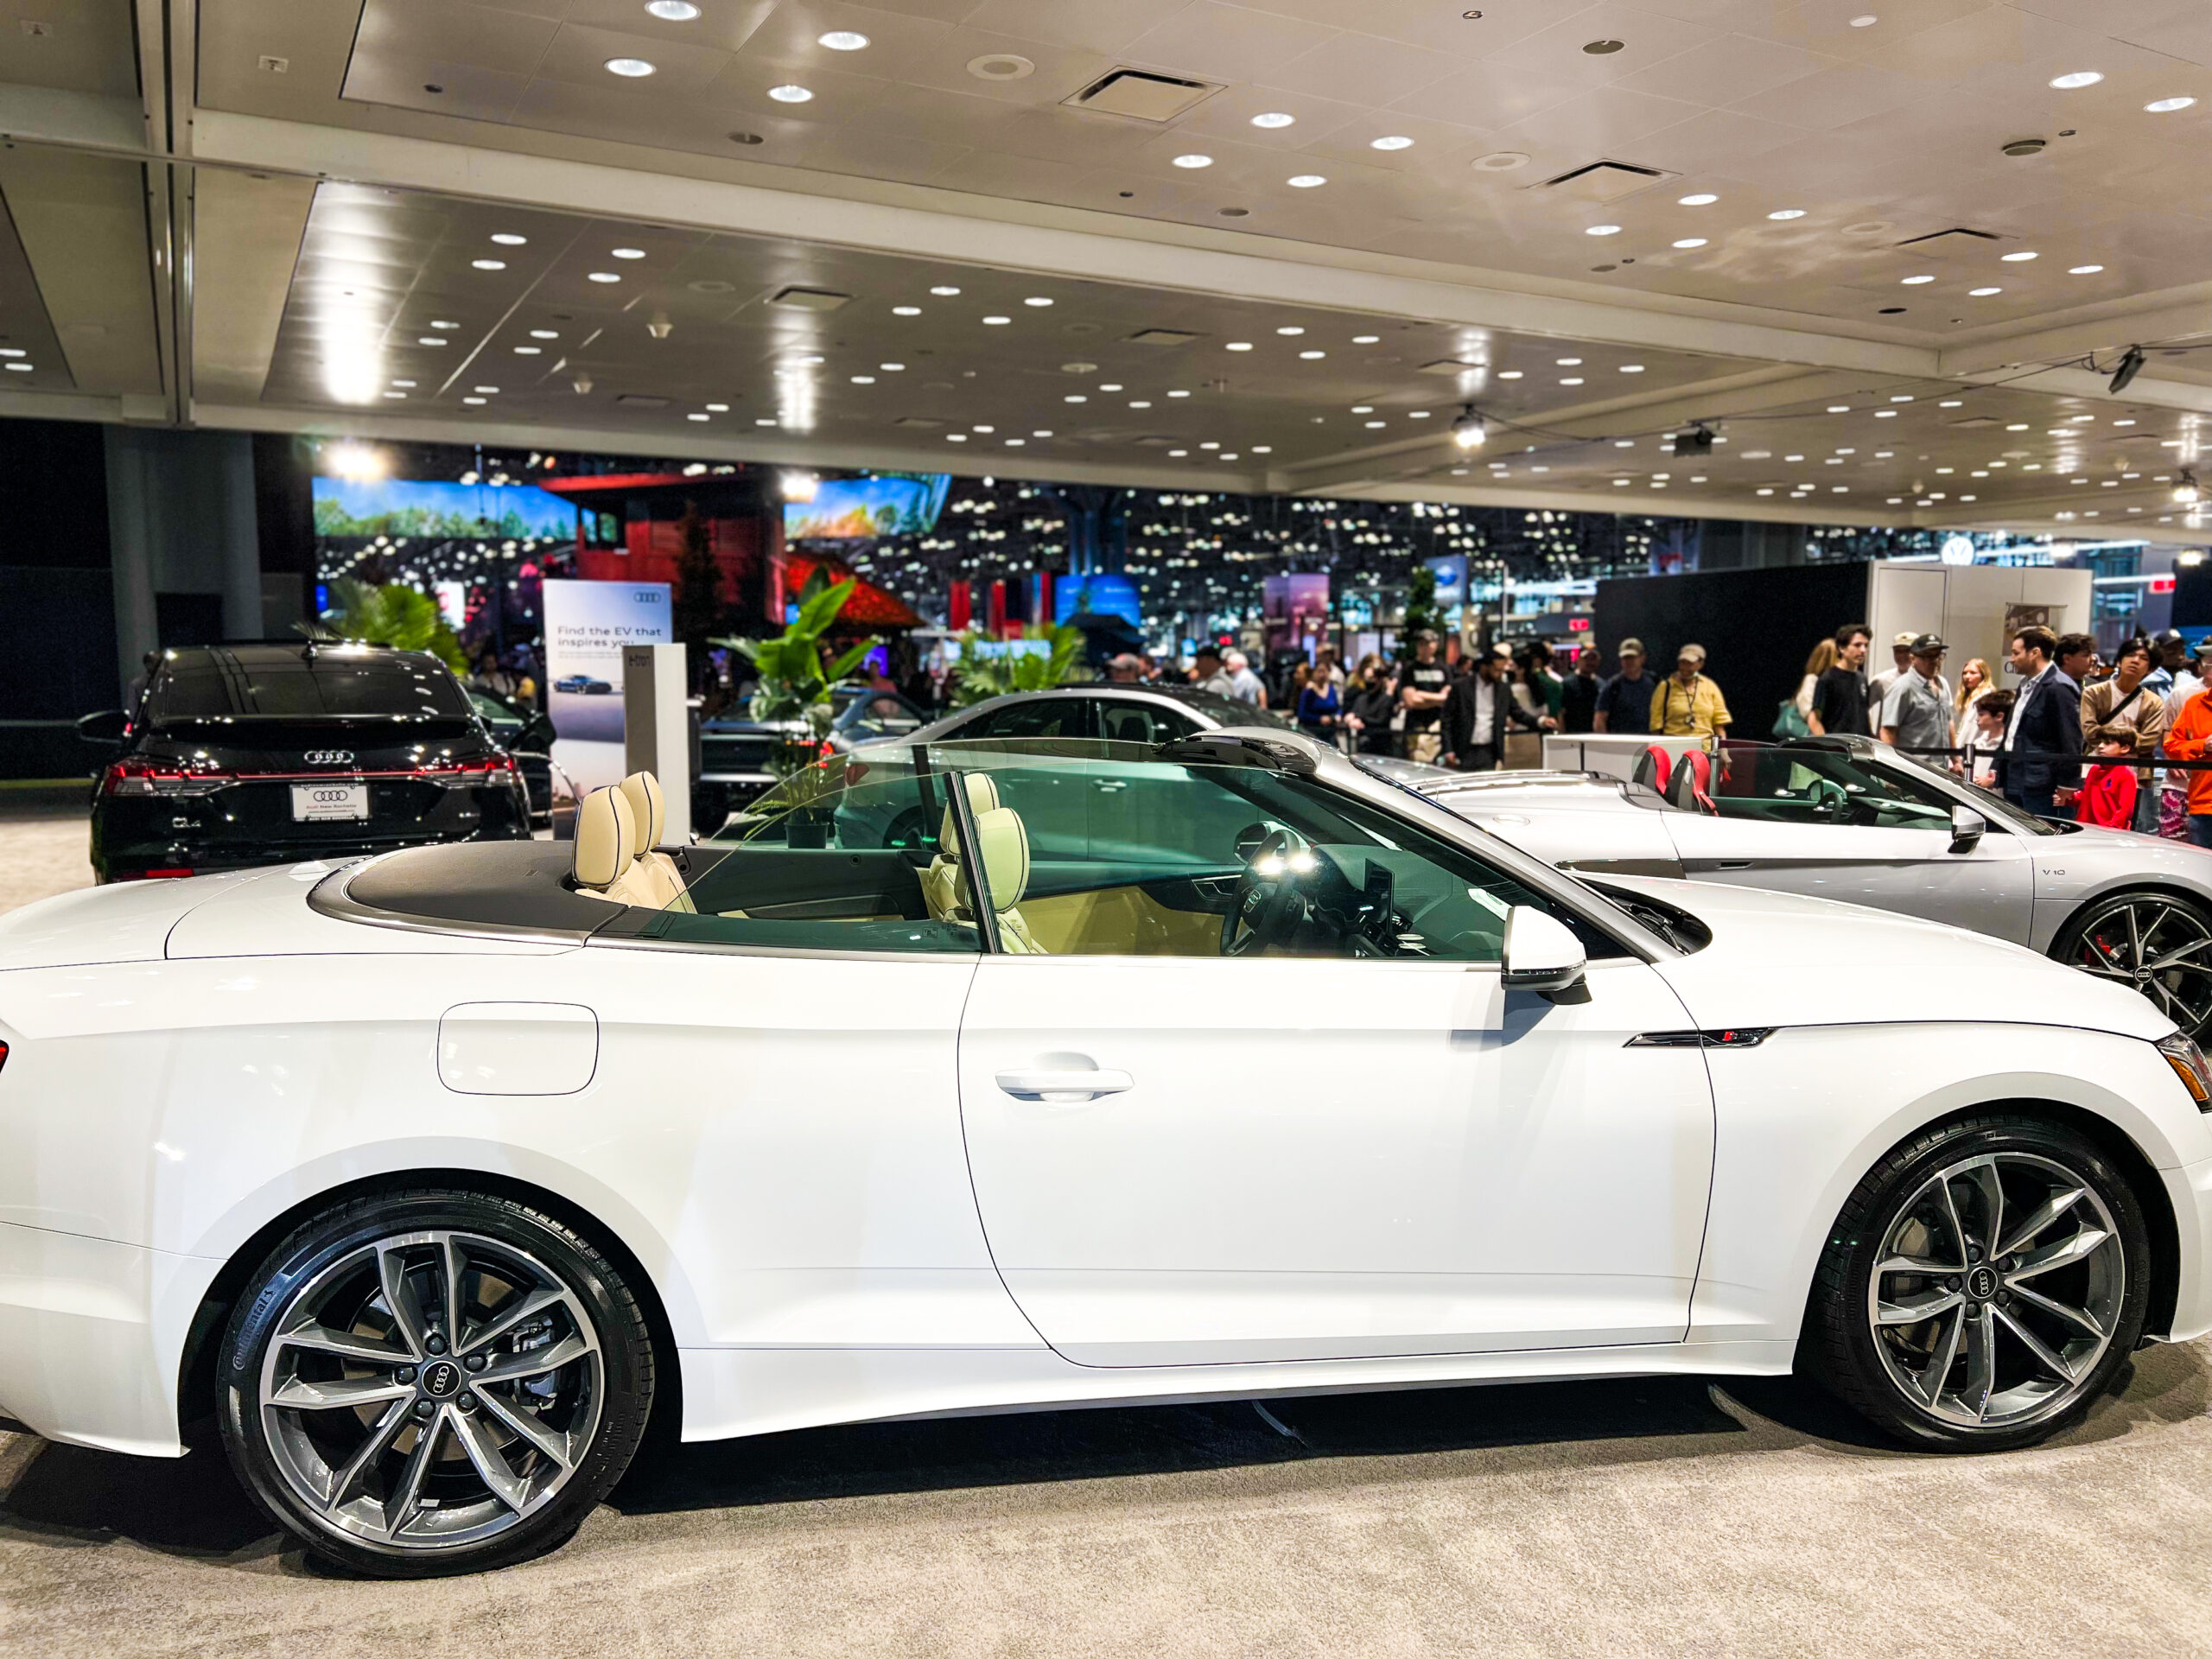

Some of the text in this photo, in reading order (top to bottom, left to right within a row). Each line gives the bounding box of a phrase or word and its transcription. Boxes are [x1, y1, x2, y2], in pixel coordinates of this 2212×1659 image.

[557, 626, 662, 636] Find the EV that
[558, 638, 607, 648] inspires
